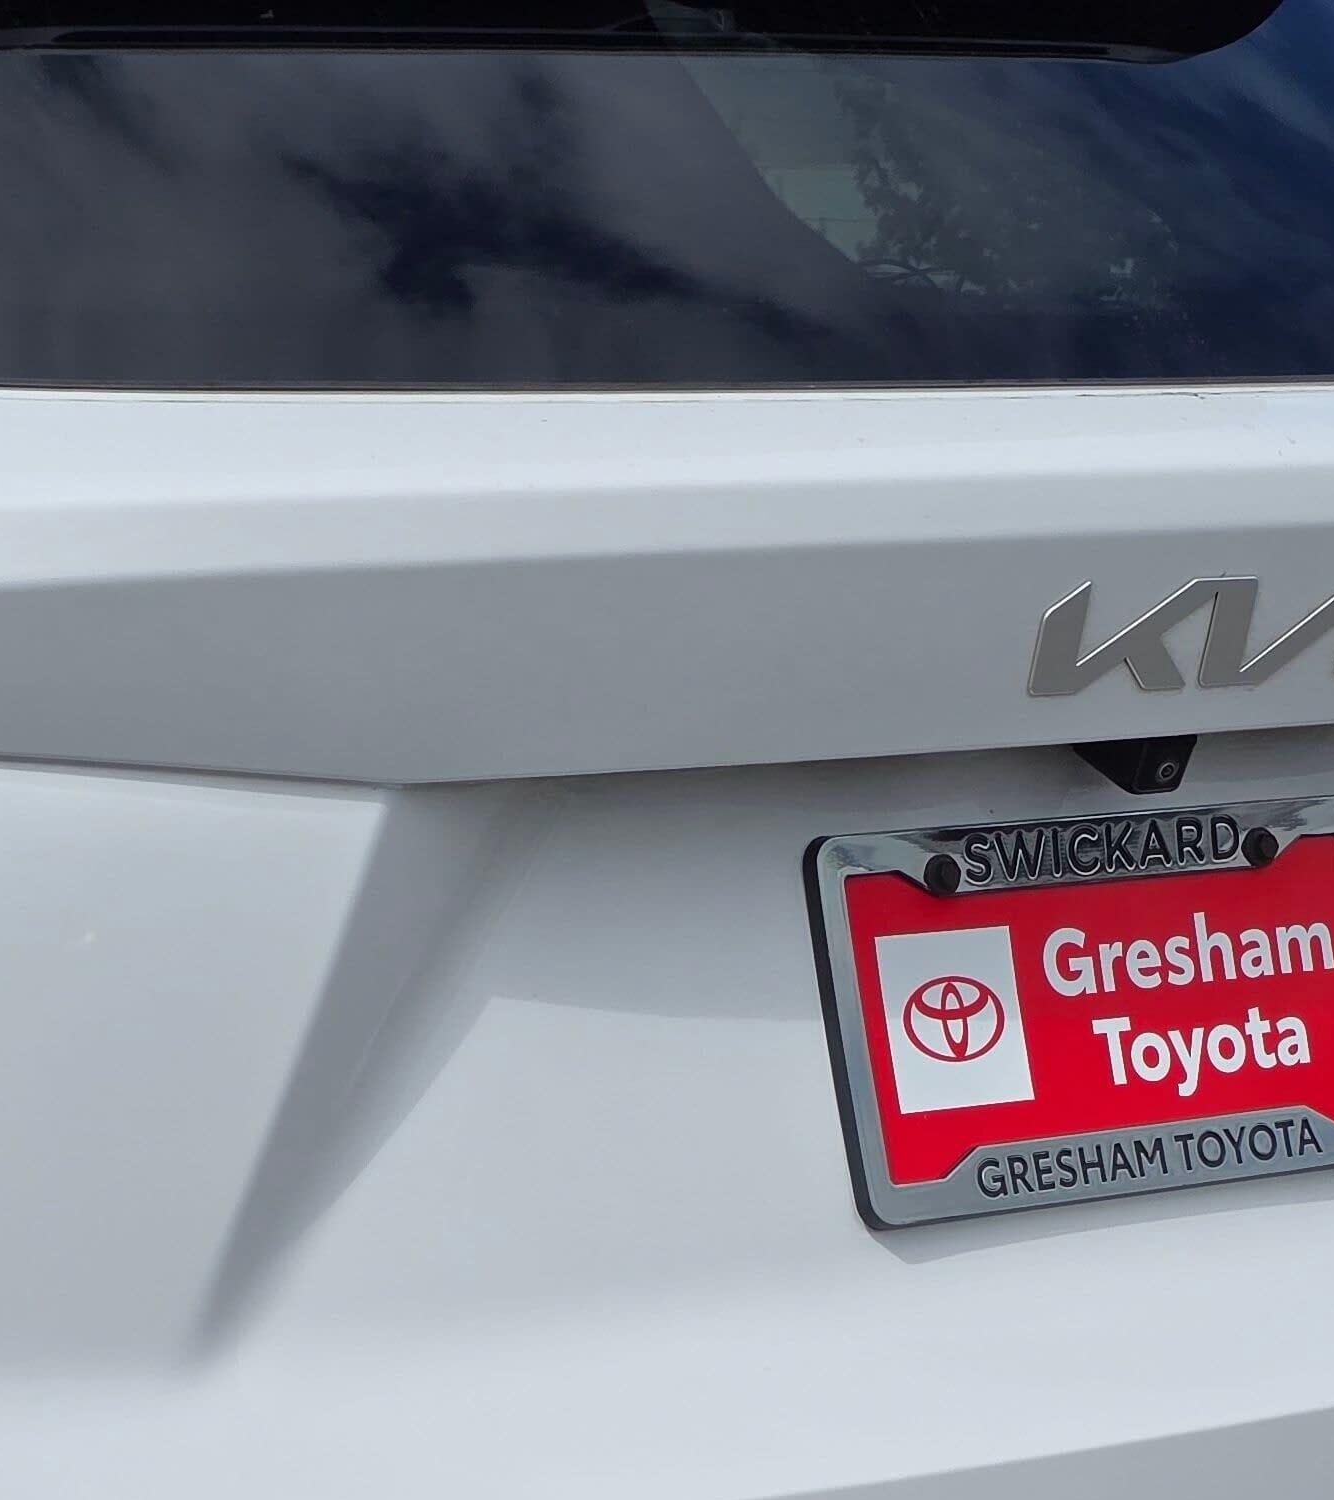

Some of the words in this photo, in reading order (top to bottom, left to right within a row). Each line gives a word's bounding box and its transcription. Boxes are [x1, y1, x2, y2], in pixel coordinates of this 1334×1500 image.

[964, 814, 1240, 884] SWICKARD
[1093, 1008, 1311, 1096] Toyota
[976, 1145, 1168, 1199] GRESHAM
[1175, 1118, 1323, 1174] TOYOTA
